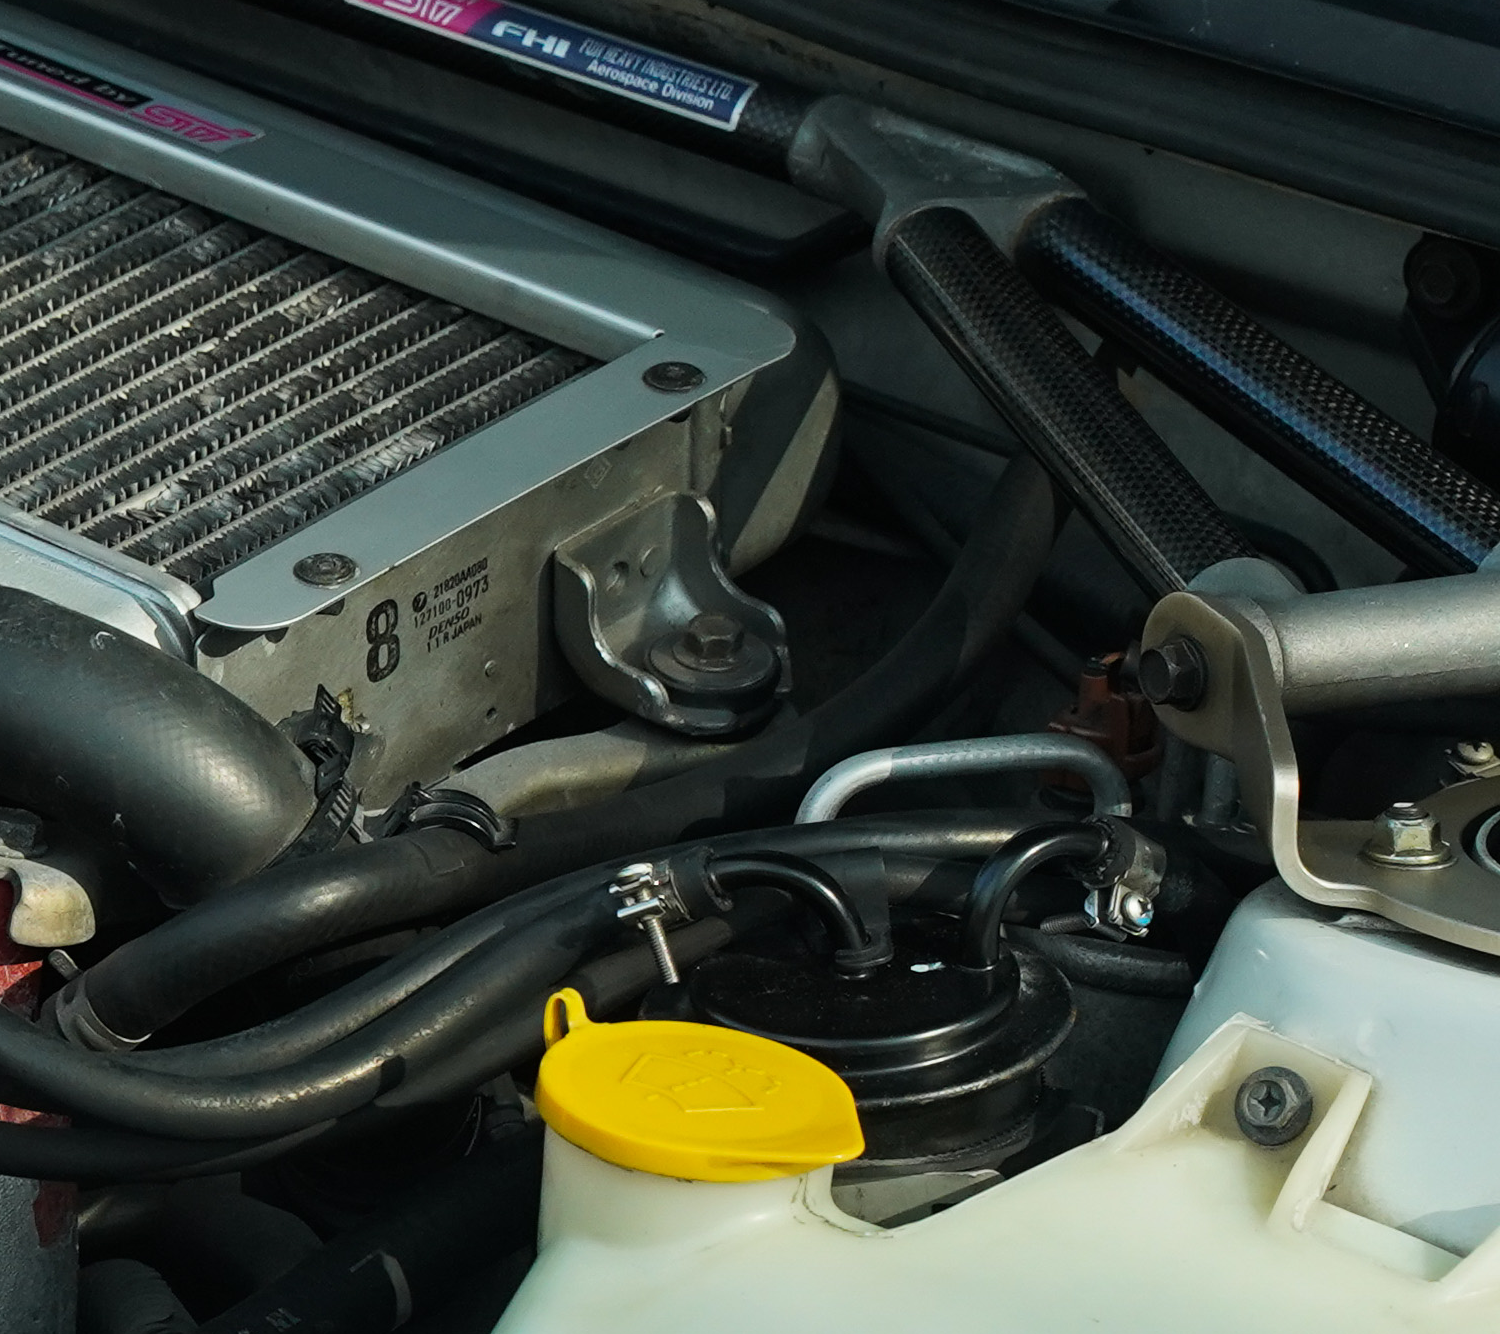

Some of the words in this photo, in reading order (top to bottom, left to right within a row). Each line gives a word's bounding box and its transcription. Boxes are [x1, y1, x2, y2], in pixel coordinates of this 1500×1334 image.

[490, 17, 572, 59] FHI
[579, 36, 609, 61] FUJI
[606, 45, 642, 72] HEAVY
[640, 56, 711, 93] INDUSTRIES
[707, 78, 734, 102] LTD.
[584, 58, 661, 95] Aerospace
[660, 82, 715, 111] Division
[92, 80, 135, 106] by
[414, 576, 490, 629] 127100-0973
[429, 608, 470, 640] DENSO
[366, 599, 400, 681] 8
[450, 614, 483, 646] JAPAN
